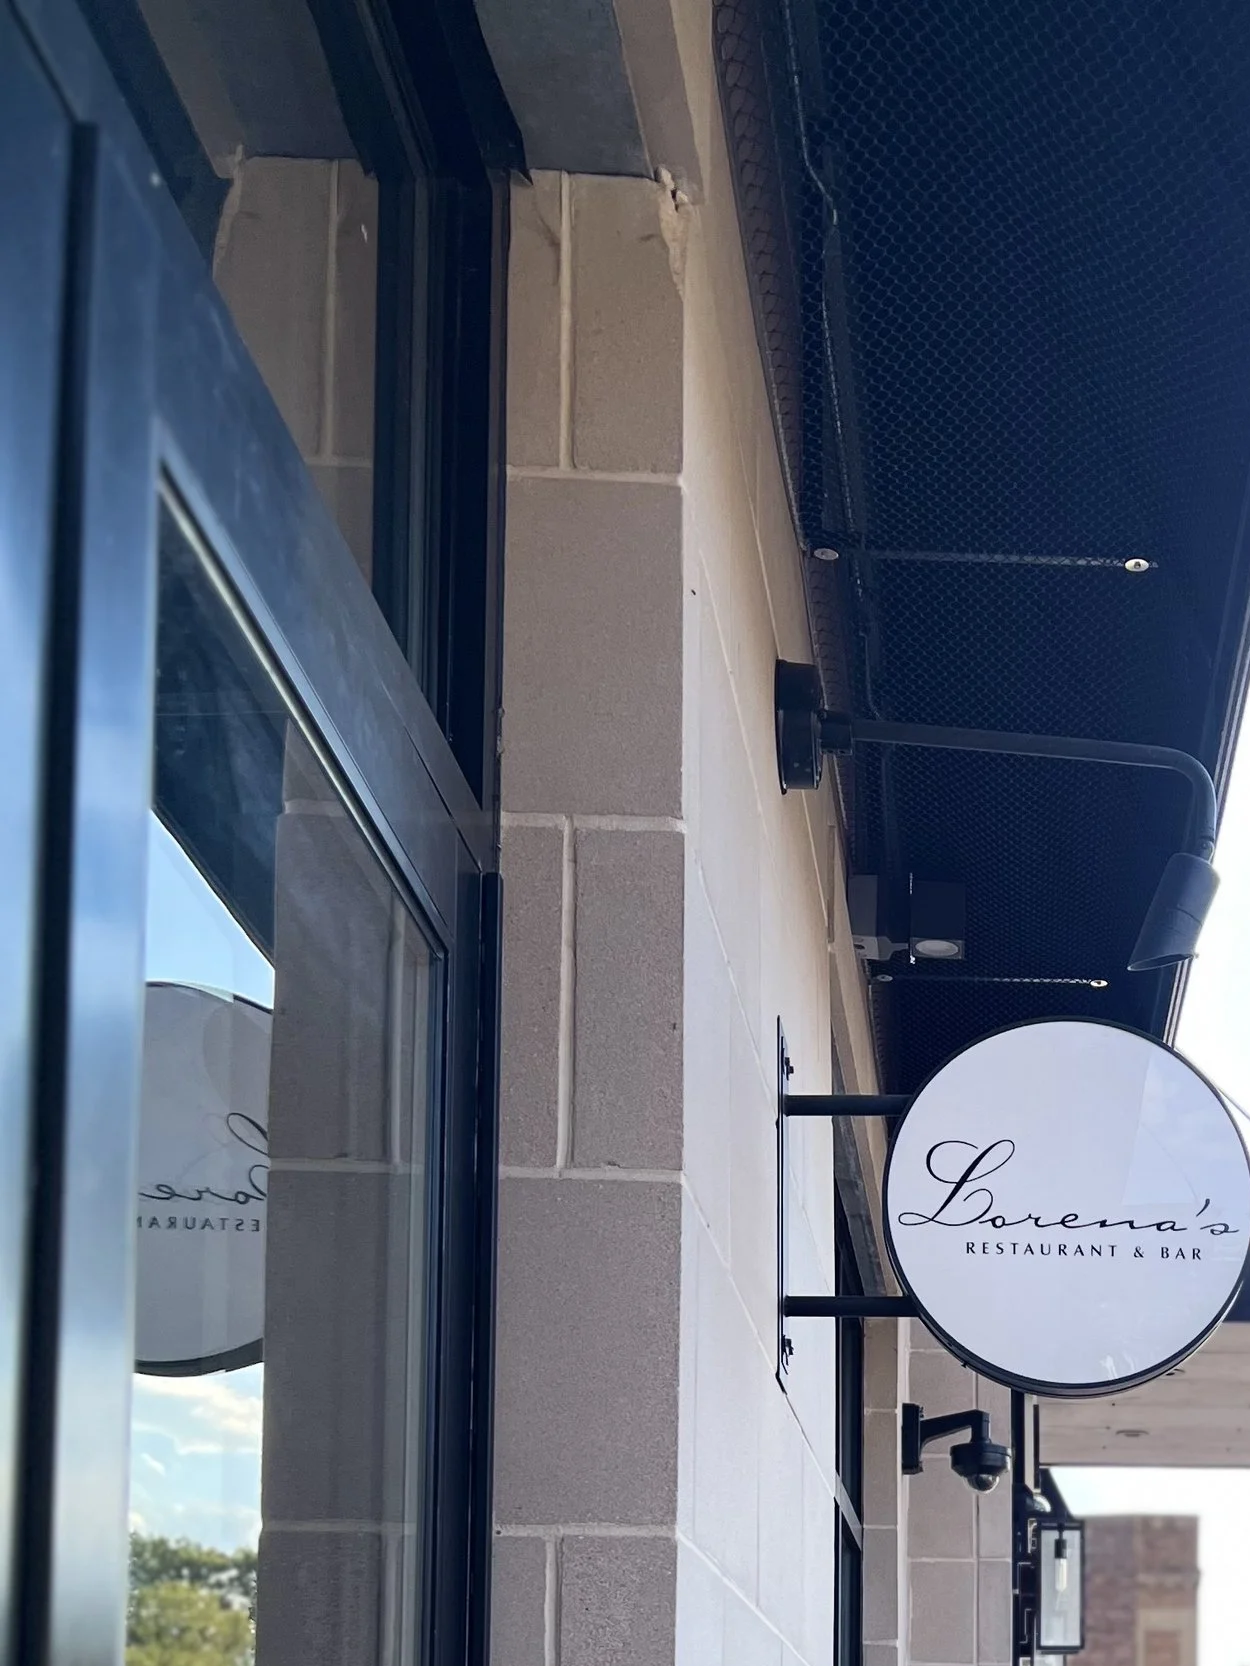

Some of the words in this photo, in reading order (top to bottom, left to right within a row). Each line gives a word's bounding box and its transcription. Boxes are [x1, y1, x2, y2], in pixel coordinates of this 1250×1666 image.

[897, 1138, 1240, 1237] Lorena's
[966, 1241, 1118, 1258] RESTAURANT
[1133, 1245, 1145, 1259] &
[1160, 1246, 1203, 1261] BAR
